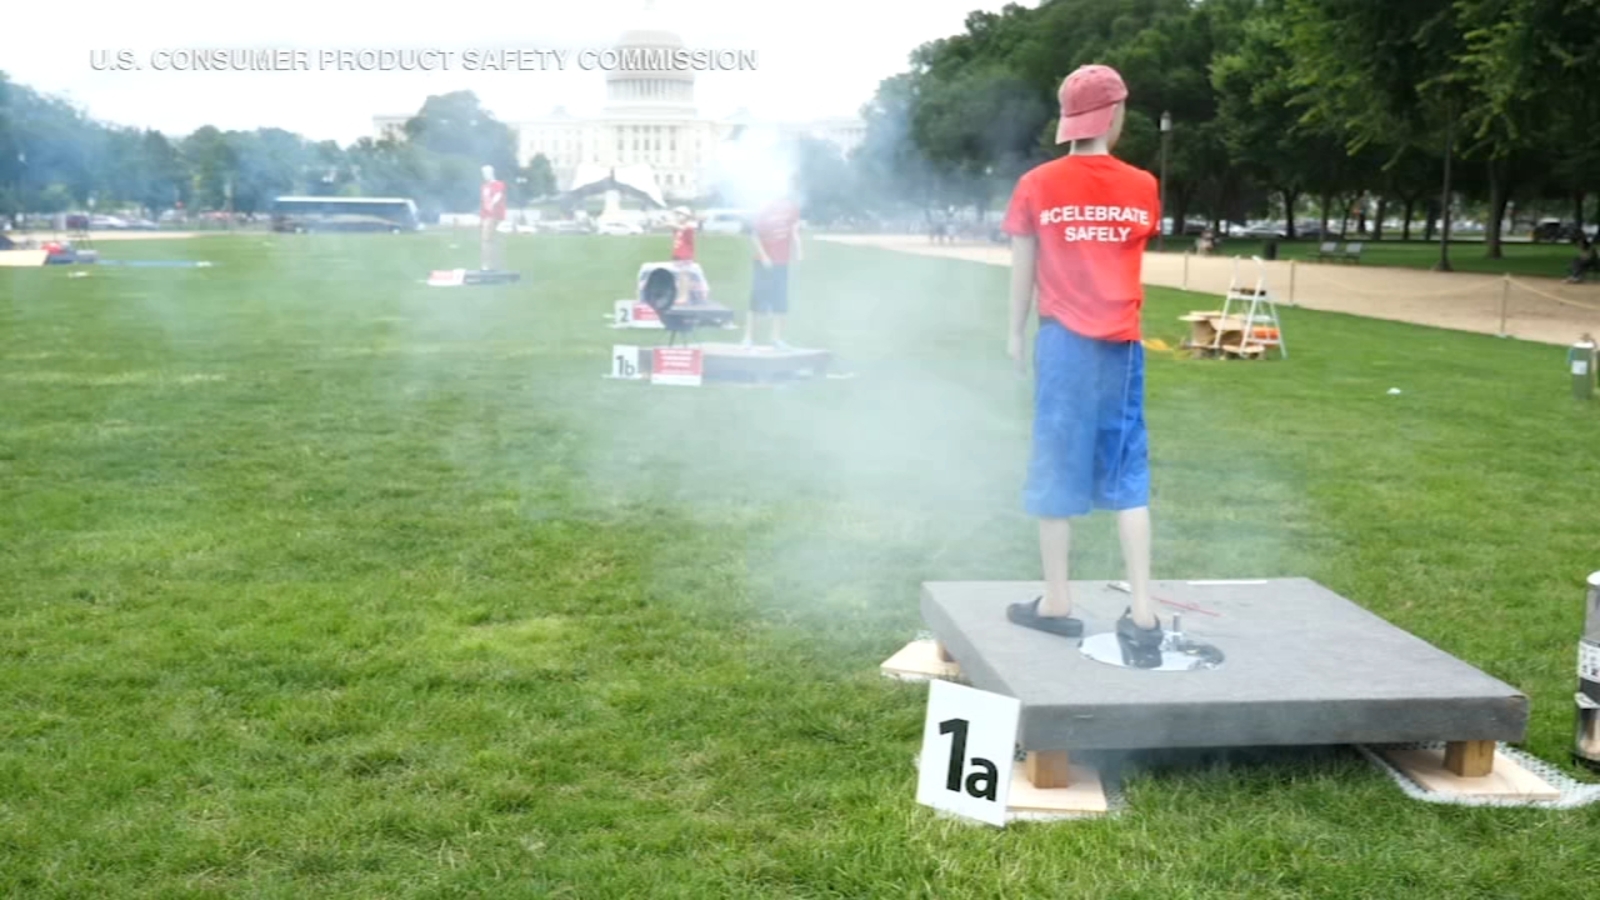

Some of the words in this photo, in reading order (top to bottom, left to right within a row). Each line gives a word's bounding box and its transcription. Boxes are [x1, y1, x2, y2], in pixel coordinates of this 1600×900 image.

[1040, 206, 1149, 225] #CELEBRATE
[1065, 226, 1131, 242] SAFELY
[619, 307, 629, 322] 2
[615, 354, 636, 376] 1b
[938, 718, 999, 803] 1a
